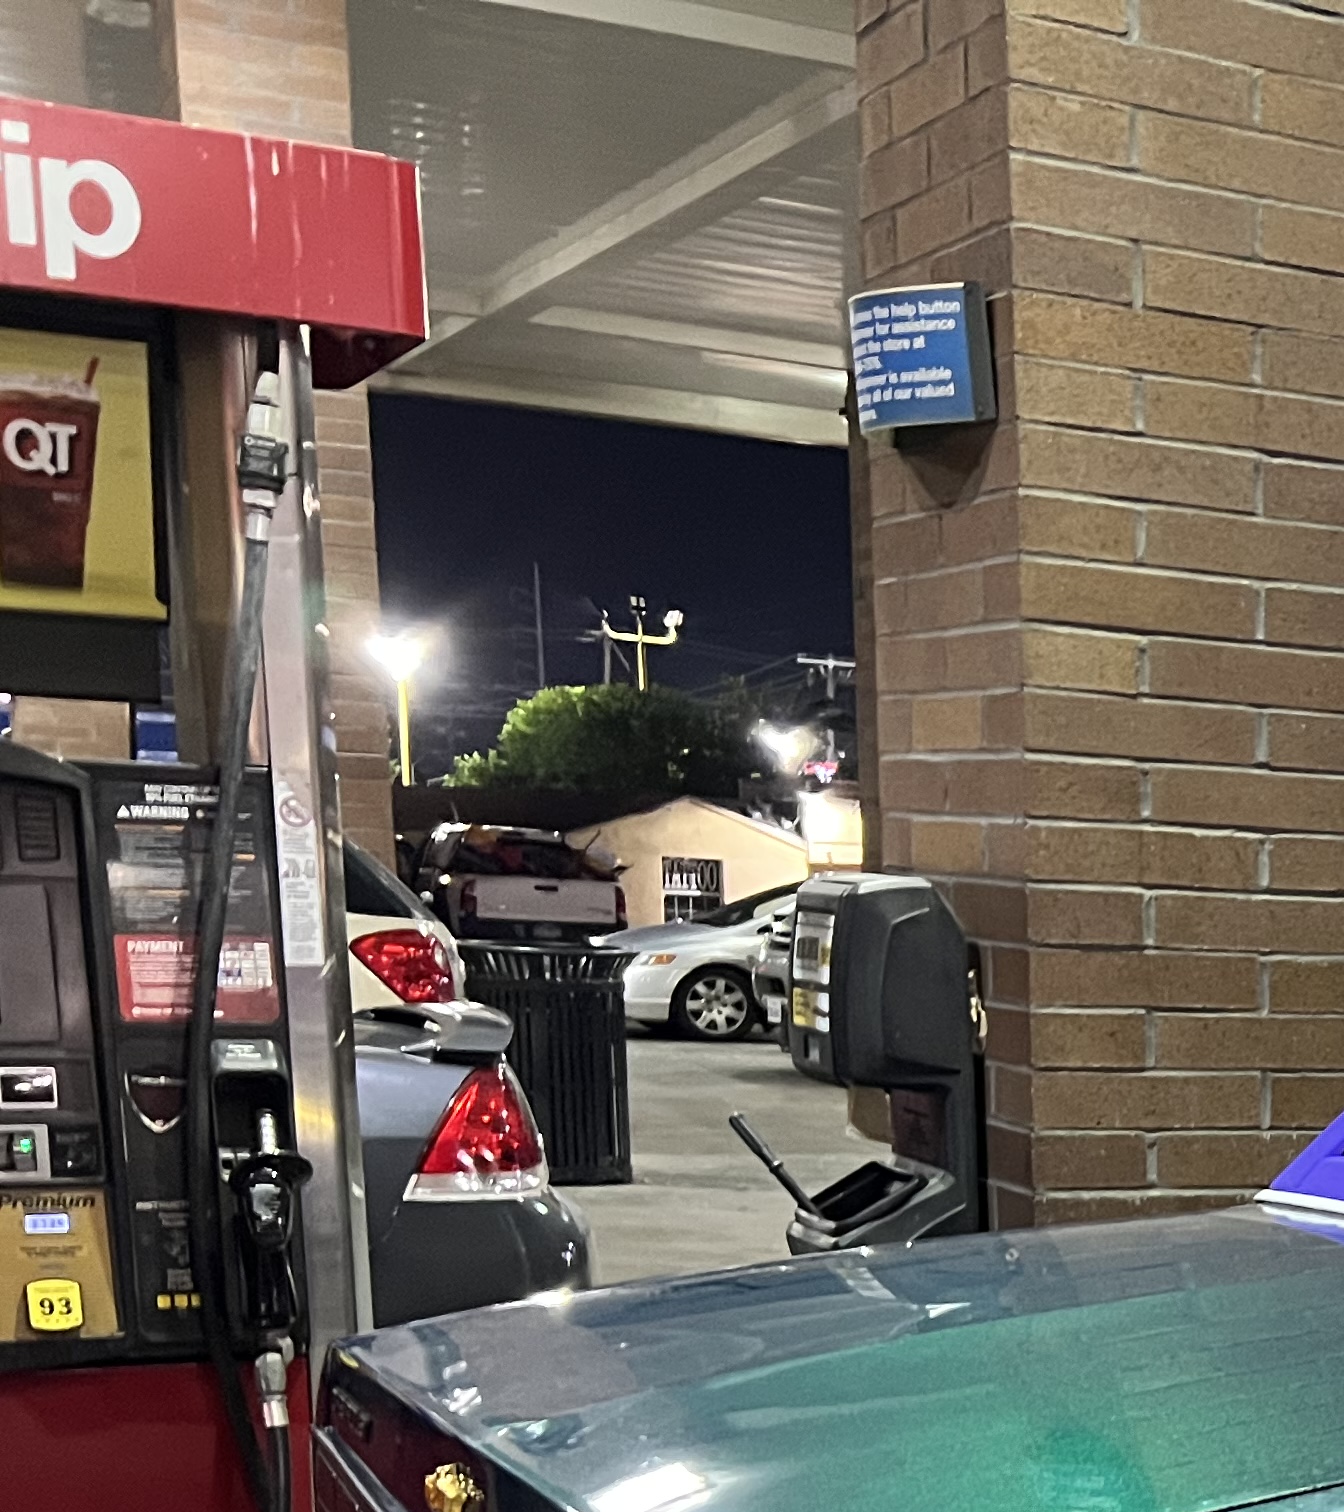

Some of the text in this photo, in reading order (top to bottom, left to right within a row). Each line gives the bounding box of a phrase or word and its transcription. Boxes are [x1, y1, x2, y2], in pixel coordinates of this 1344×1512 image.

[0, 120, 142, 280] ip
[918, 300, 960, 315] button
[3, 418, 77, 476] QT
[130, 805, 190, 820] WARNING
[127, 940, 185, 954] PAYMENT
[0, 1192, 96, 1209] Premium
[39, 1297, 73, 1316] 93
